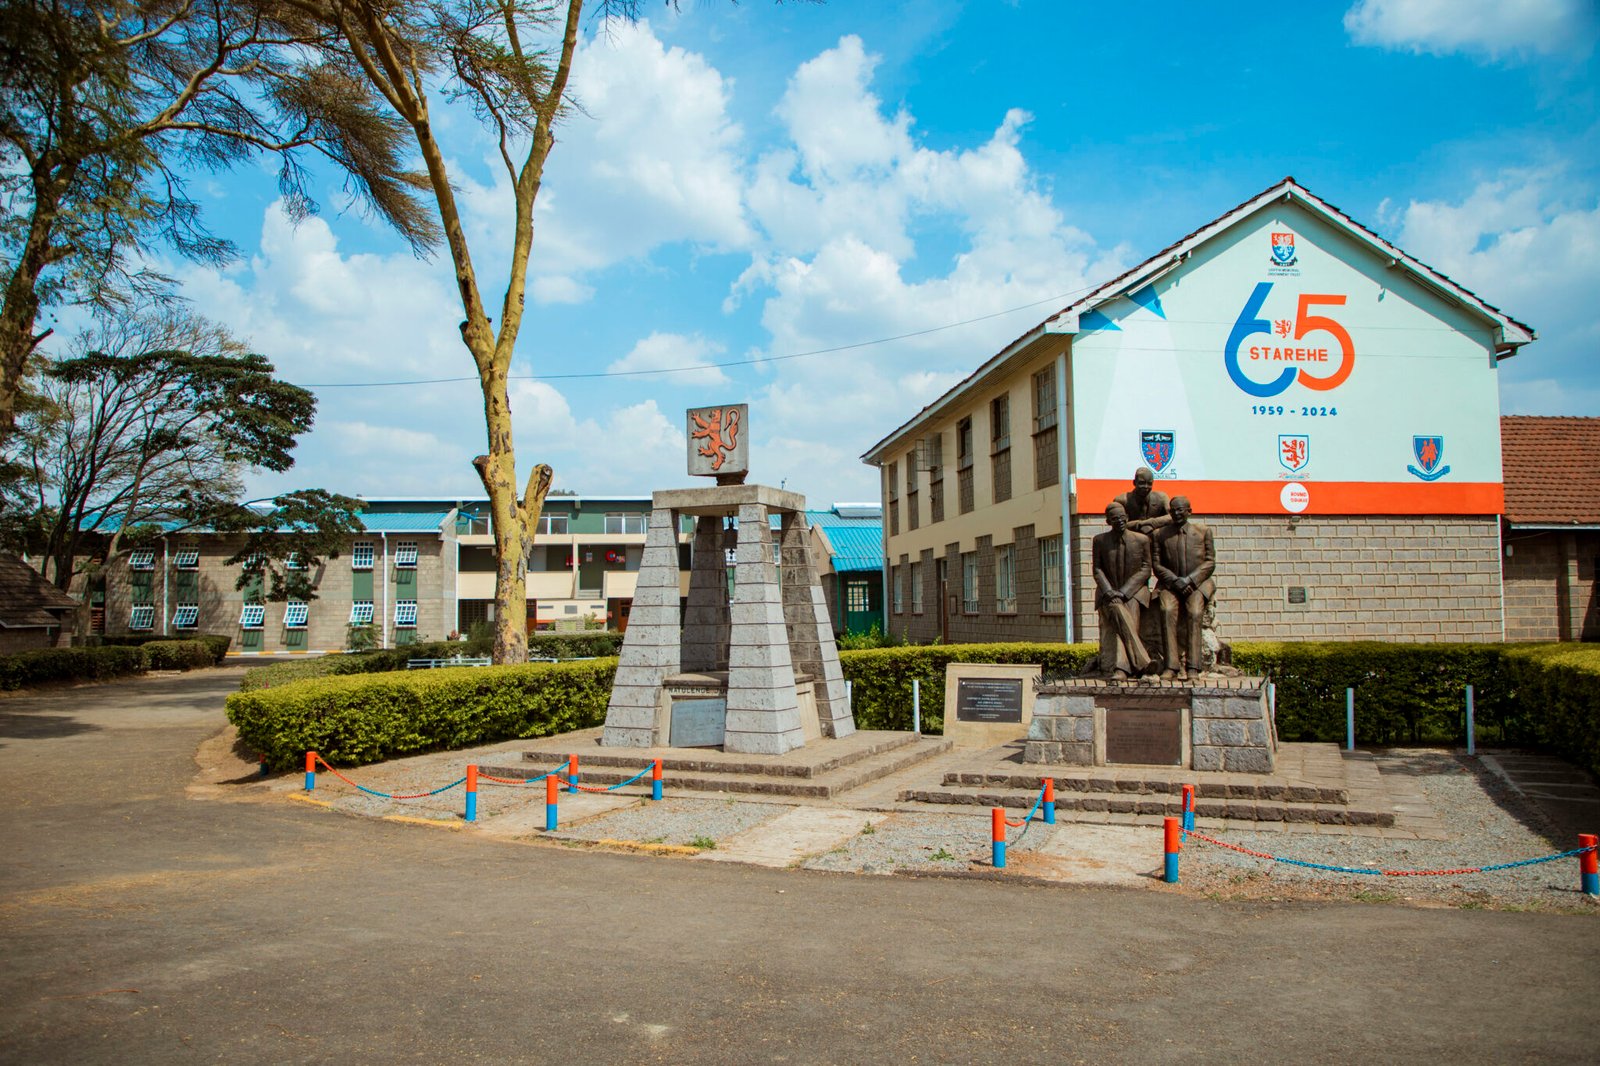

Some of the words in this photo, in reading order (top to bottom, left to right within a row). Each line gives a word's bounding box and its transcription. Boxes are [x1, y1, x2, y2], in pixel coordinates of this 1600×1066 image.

[1224, 281, 1355, 398] 65
[1250, 347, 1328, 362] STAREHE
[1252, 406, 1284, 416] 1959
[1302, 407, 1337, 416] 2024
